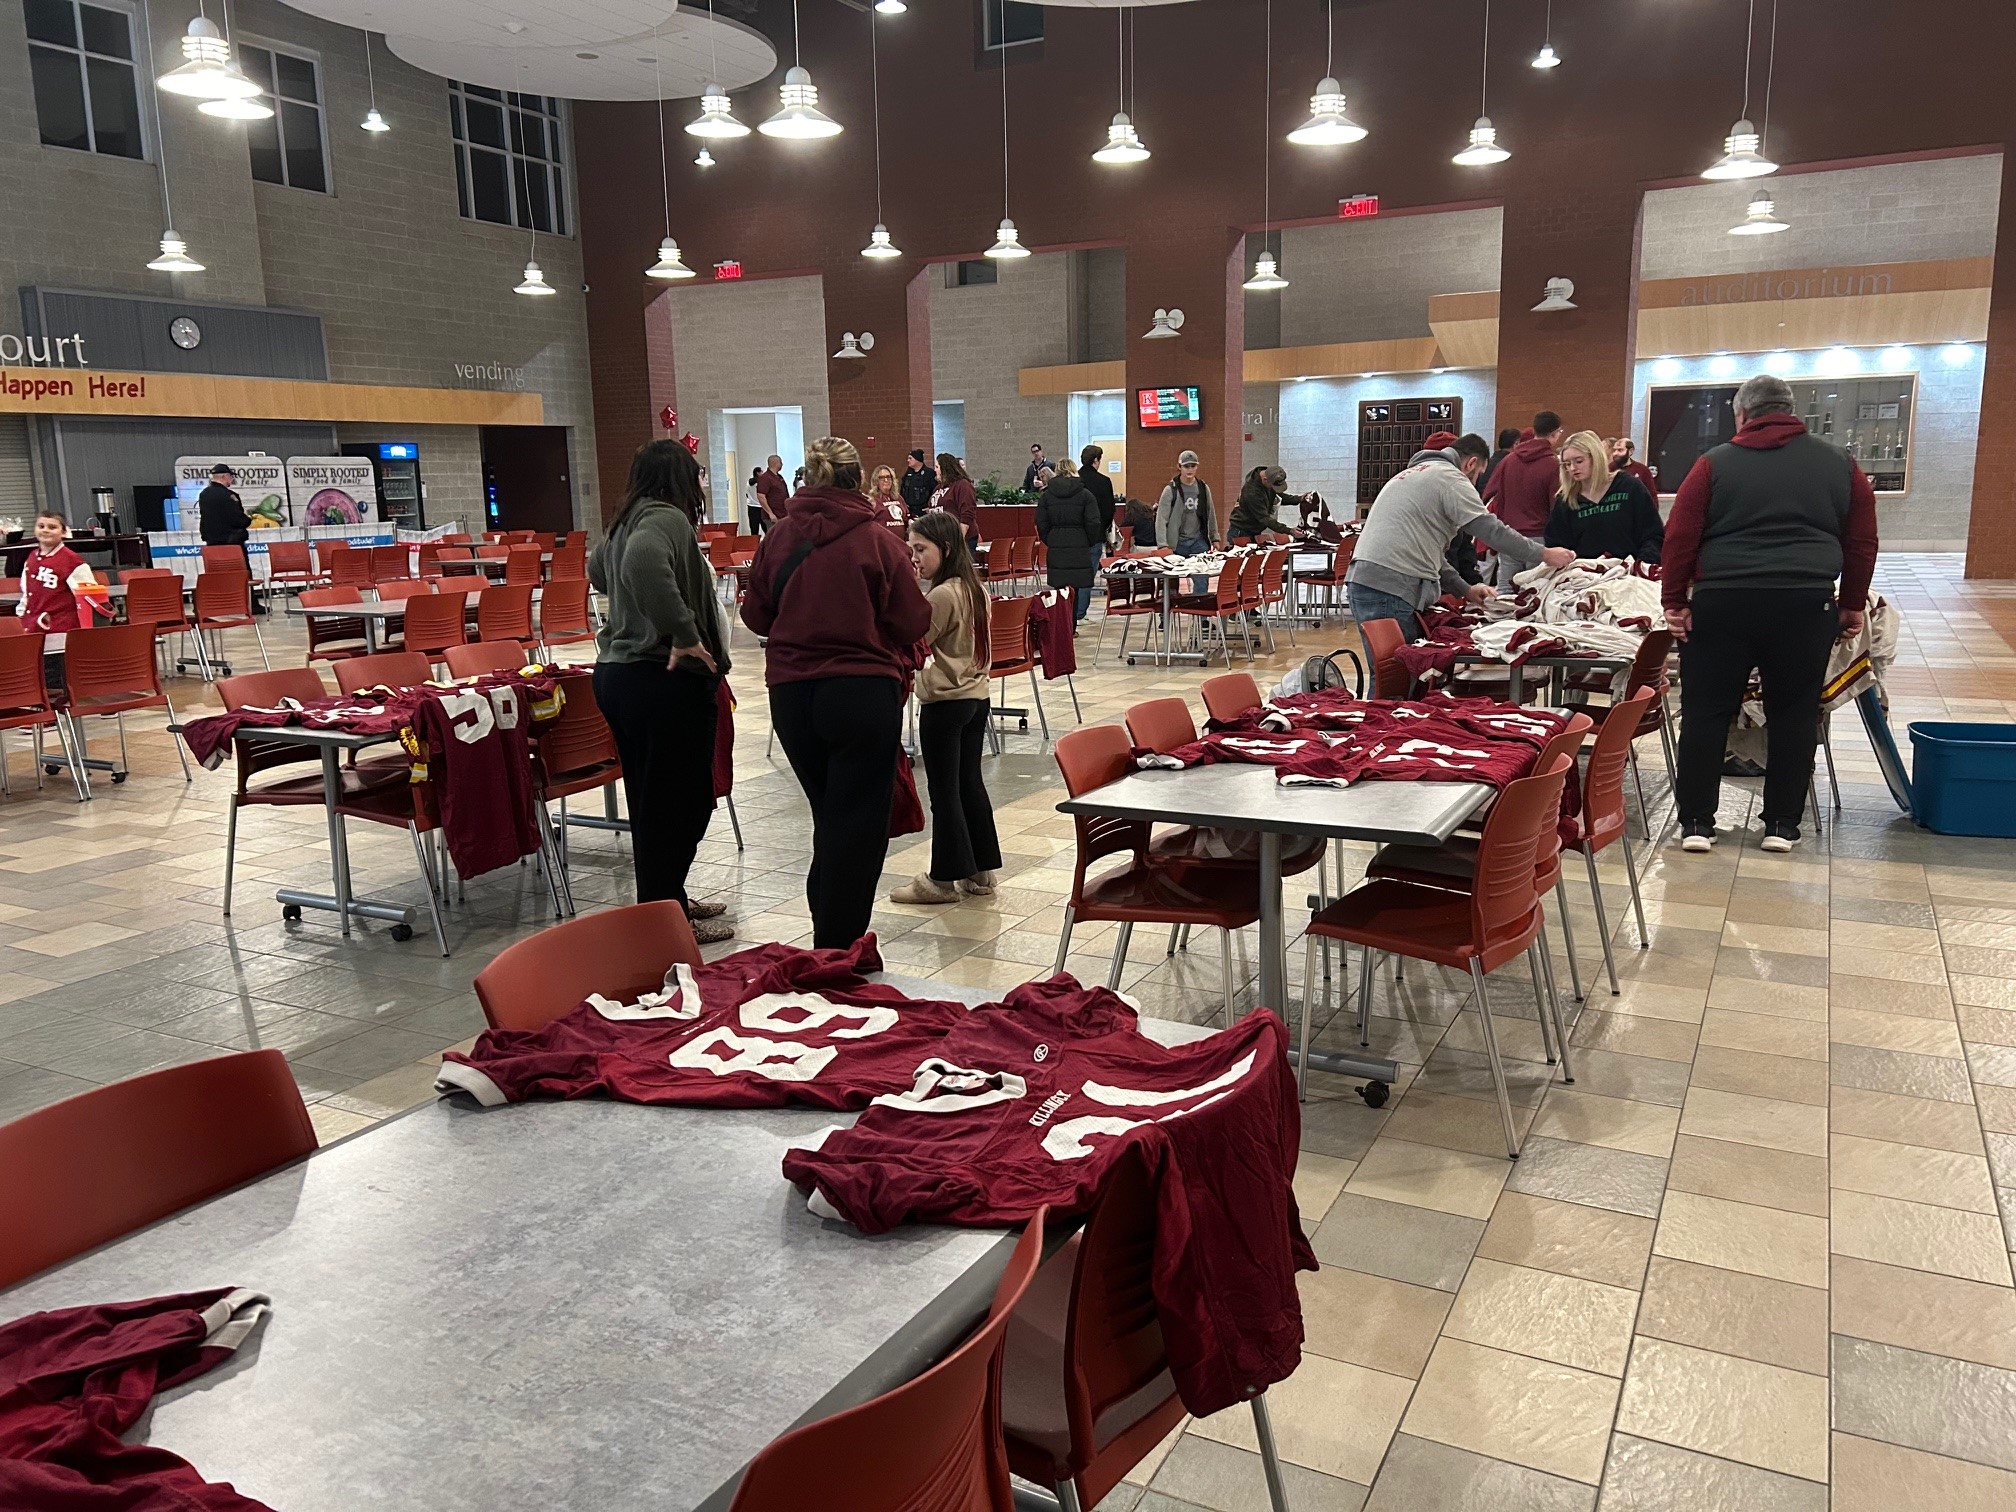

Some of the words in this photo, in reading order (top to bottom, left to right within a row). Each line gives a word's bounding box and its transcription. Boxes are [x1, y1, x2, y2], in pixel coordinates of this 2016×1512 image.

[1356, 200, 1373, 215] EXIT
[1680, 269, 1894, 306] auditorium
[454, 361, 525, 388] vending
[88, 375, 145, 399] Here!
[183, 468, 212, 479] SIMP
[293, 467, 328, 479] SIMPLY
[330, 467, 369, 479] ROOTED
[240, 478, 269, 486] family
[339, 477, 362, 486] family
[1028, 1089, 1072, 1127] KILLINGLY
